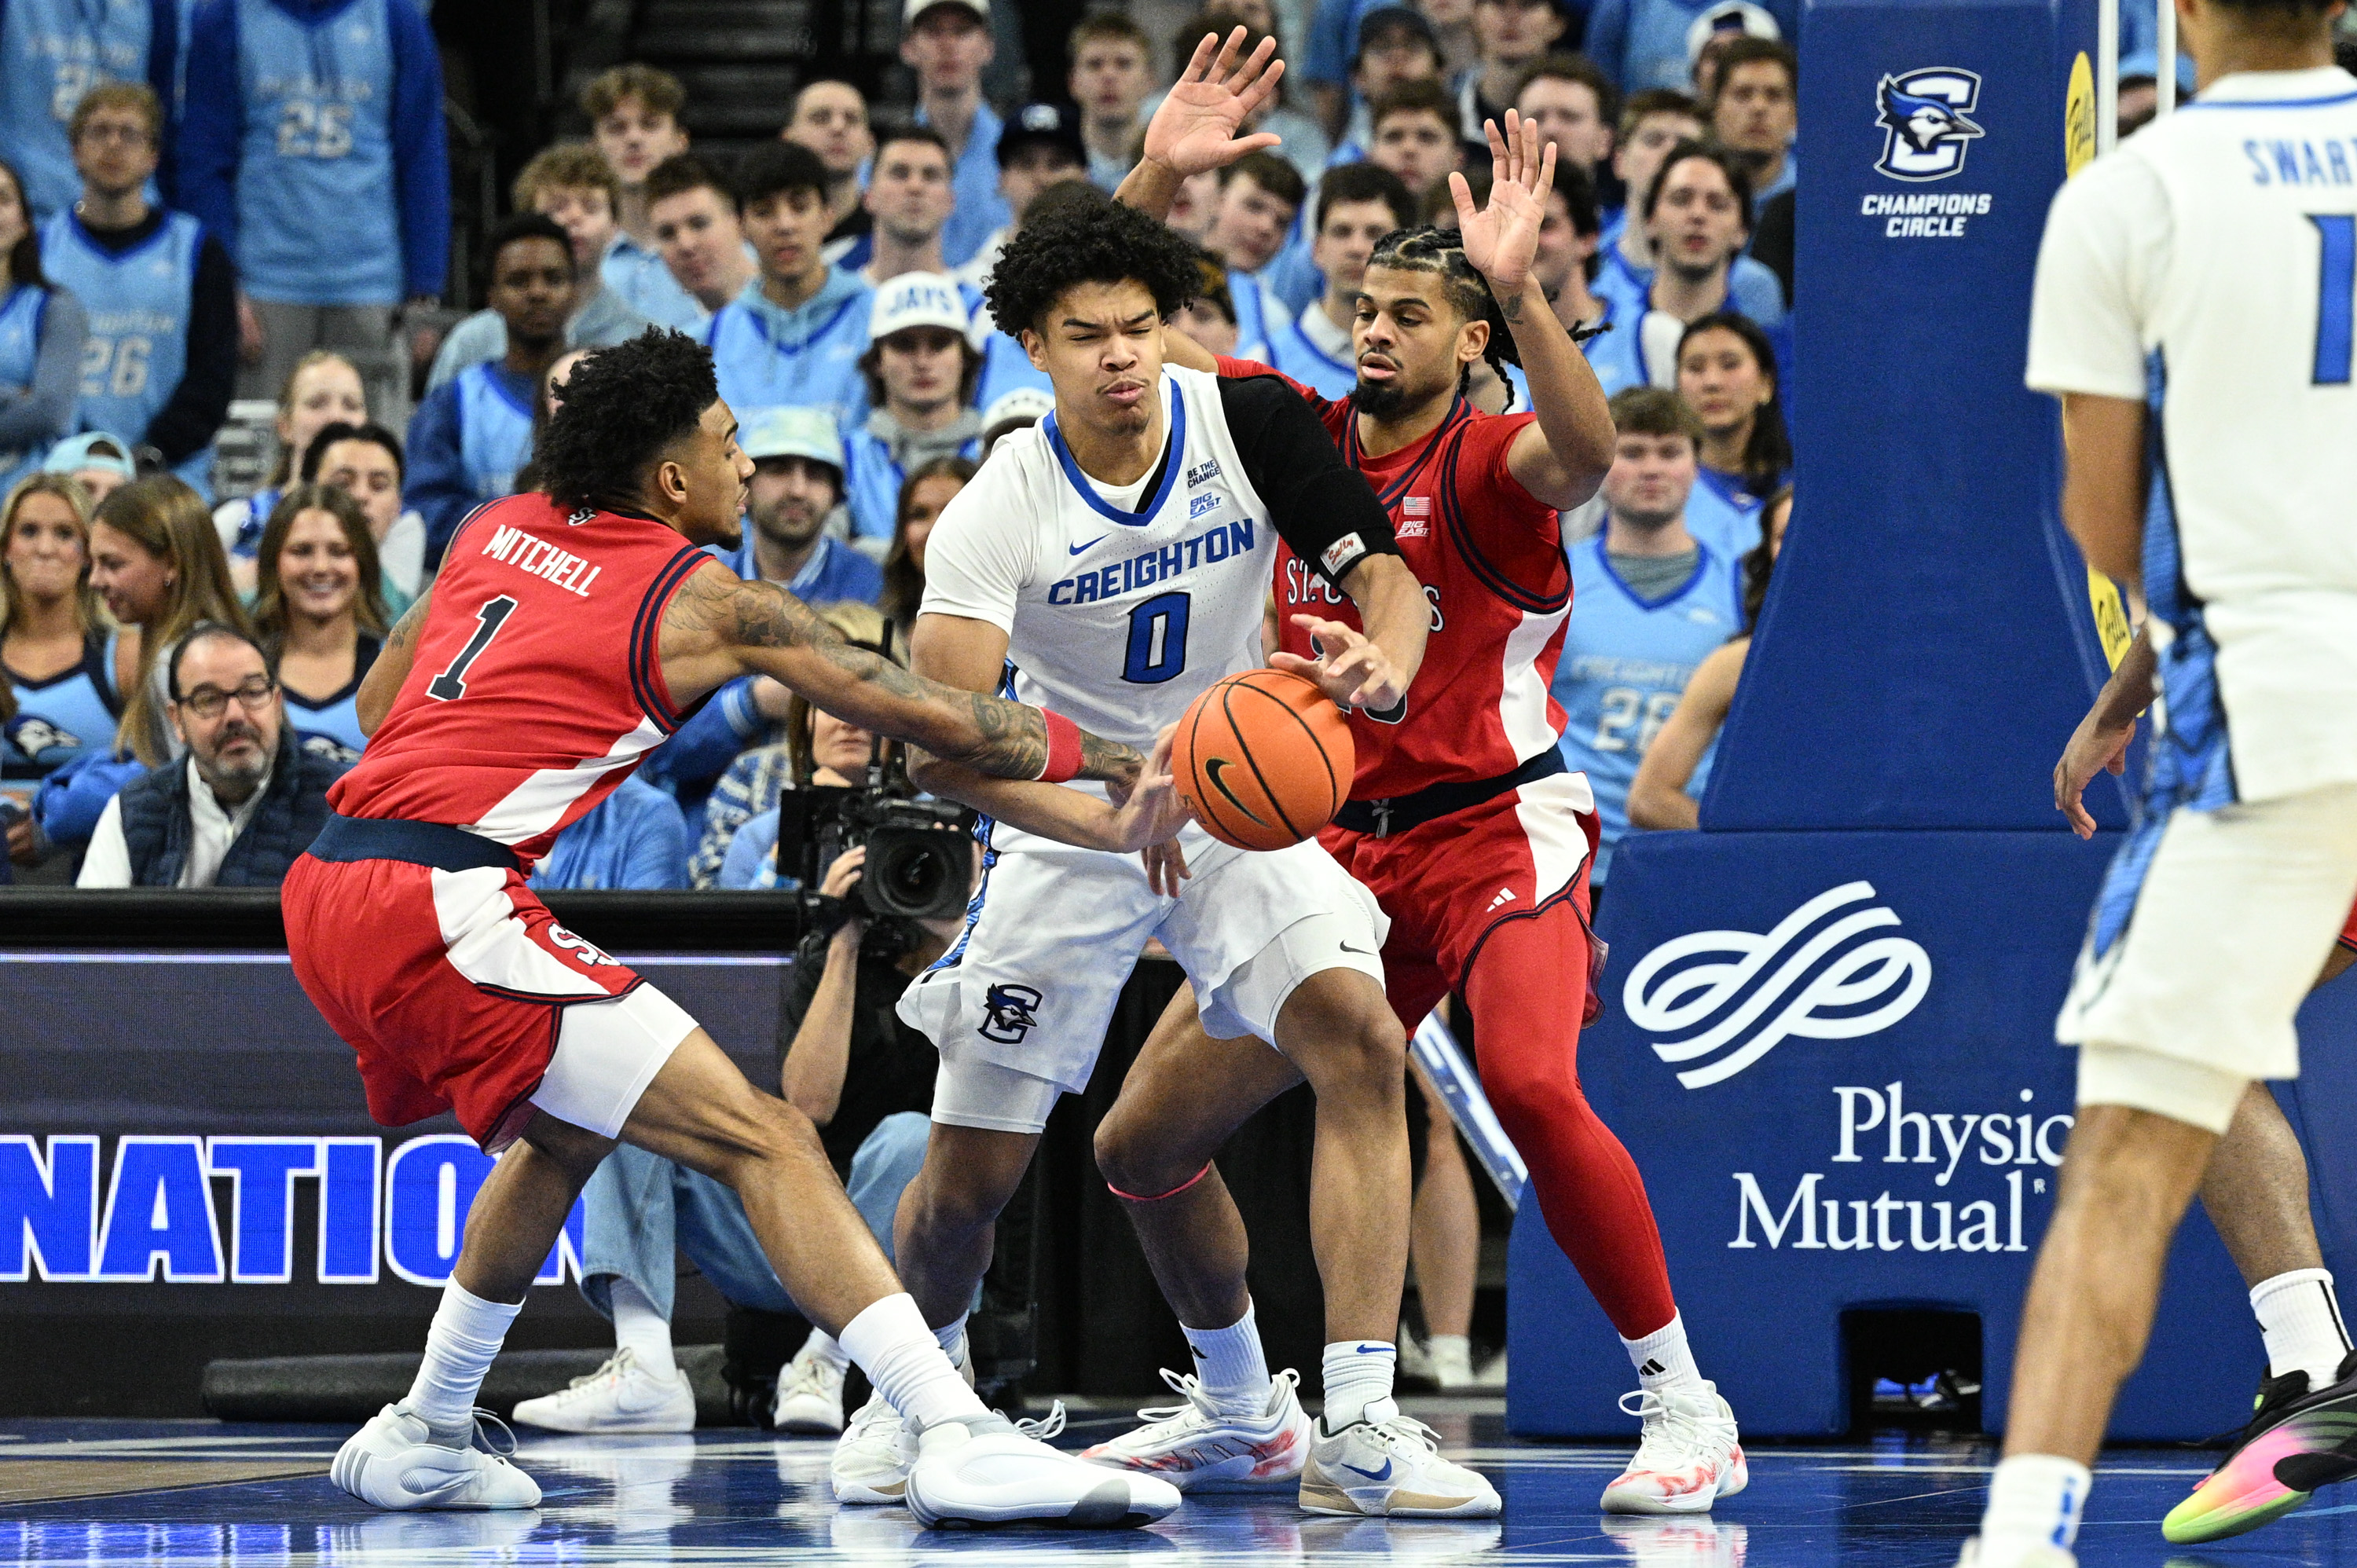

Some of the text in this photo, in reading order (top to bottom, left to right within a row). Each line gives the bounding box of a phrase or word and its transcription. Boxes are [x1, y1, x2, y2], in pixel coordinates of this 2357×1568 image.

[2242, 139, 2357, 186] SWAR
[1861, 193, 1992, 215] CHAMPIONS
[1886, 216, 1967, 237] CIRCLE
[886, 286, 951, 316] JAYS
[2301, 212, 2356, 386] 1
[79, 335, 152, 397] 26
[1187, 460, 1215, 479] BE THE
[1187, 467, 1220, 489] CHANGE
[1190, 492, 1212, 507] BIG
[1190, 497, 1222, 515] EAST
[1398, 527, 1431, 536] EAST
[1402, 520, 1426, 529] BIG
[481, 524, 602, 597] MITCHELL
[1047, 518, 1255, 605] CREIGHTON
[425, 594, 519, 702] 1
[1120, 592, 1191, 684] 0
[1831, 1080, 2076, 1187] Physic
[1728, 1169, 2029, 1252] Mutual
